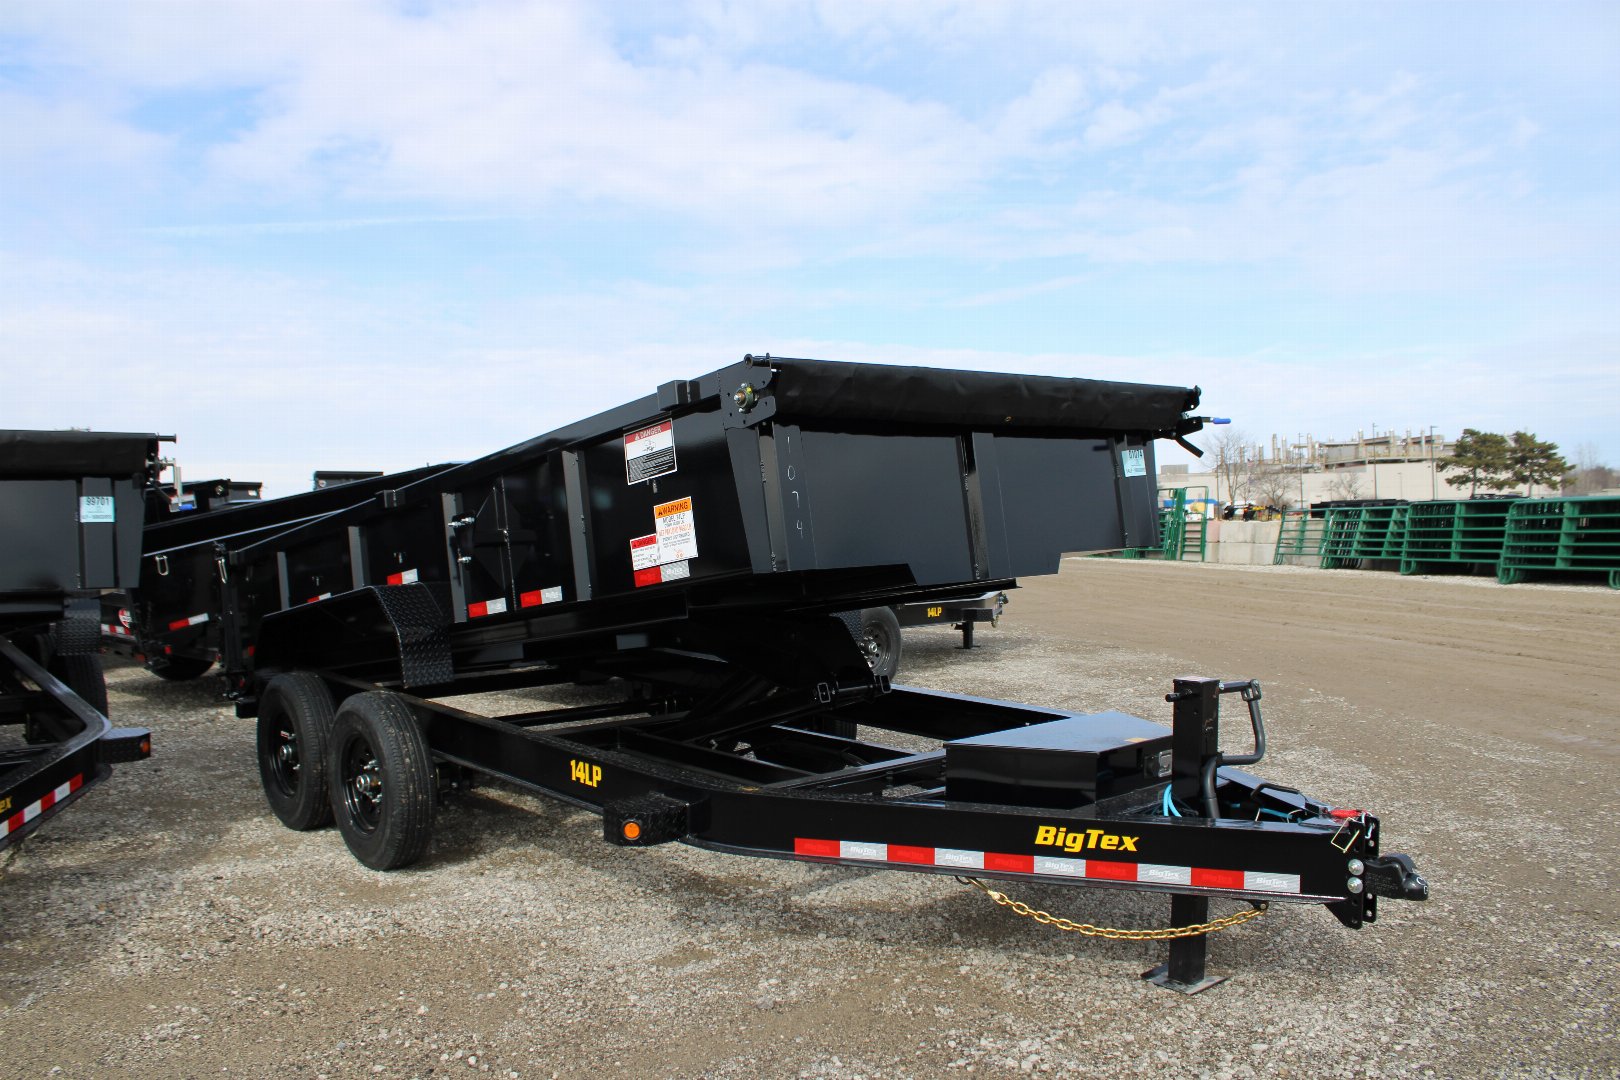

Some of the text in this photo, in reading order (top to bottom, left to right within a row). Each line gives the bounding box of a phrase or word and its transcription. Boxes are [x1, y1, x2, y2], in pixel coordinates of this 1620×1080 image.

[640, 426, 662, 439] DANGER
[663, 501, 689, 514] WARNING
[570, 760, 602, 788] 14LP
[1034, 825, 1140, 853] BigTex
